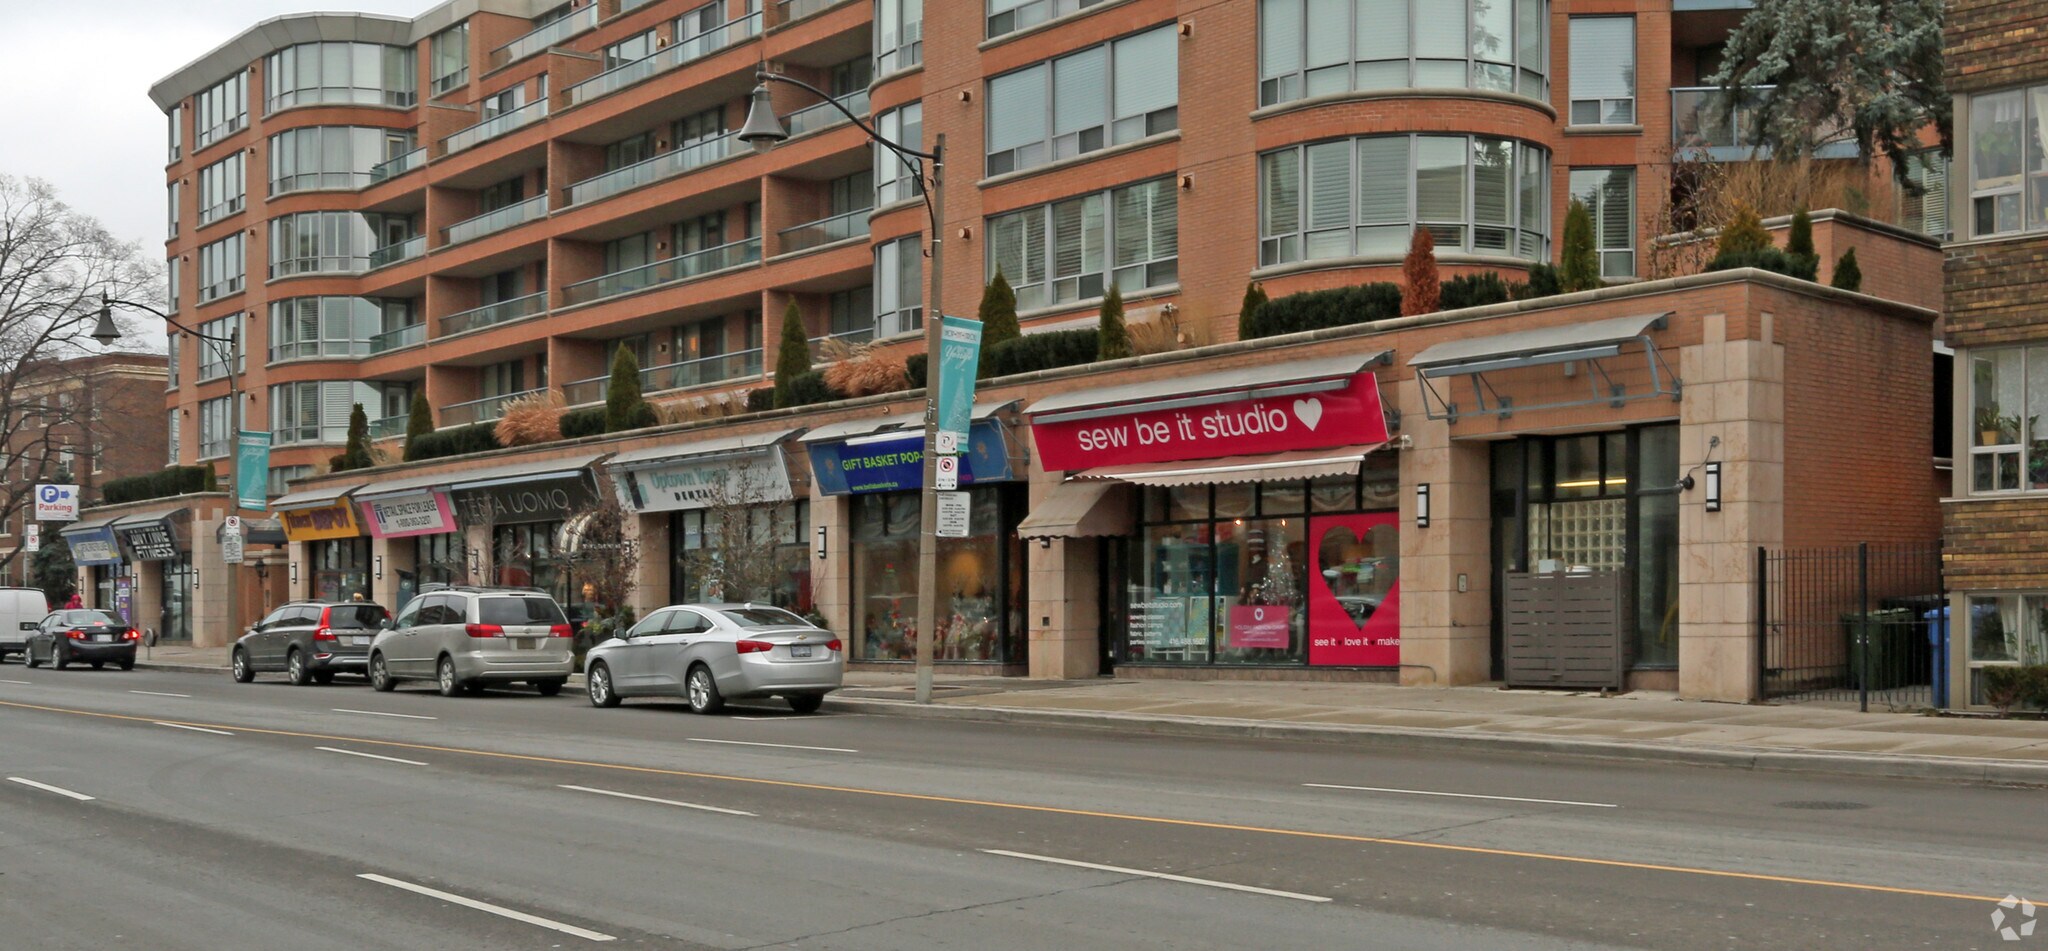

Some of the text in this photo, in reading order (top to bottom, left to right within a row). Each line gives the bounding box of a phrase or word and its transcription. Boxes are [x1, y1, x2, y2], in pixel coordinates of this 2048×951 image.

[1077, 403, 1288, 452] sew be it studio
[842, 458, 862, 471] GIFT
[863, 454, 899, 469] BASKET
[650, 470, 696, 492] Uptown
[508, 488, 569, 514] UOMO
[673, 488, 715, 502] DENTAL
[38, 503, 72, 513] Parking
[420, 499, 437, 513] LEASE
[136, 543, 175, 558] FITNESS
[1314, 637, 1400, 646] see it love it make
